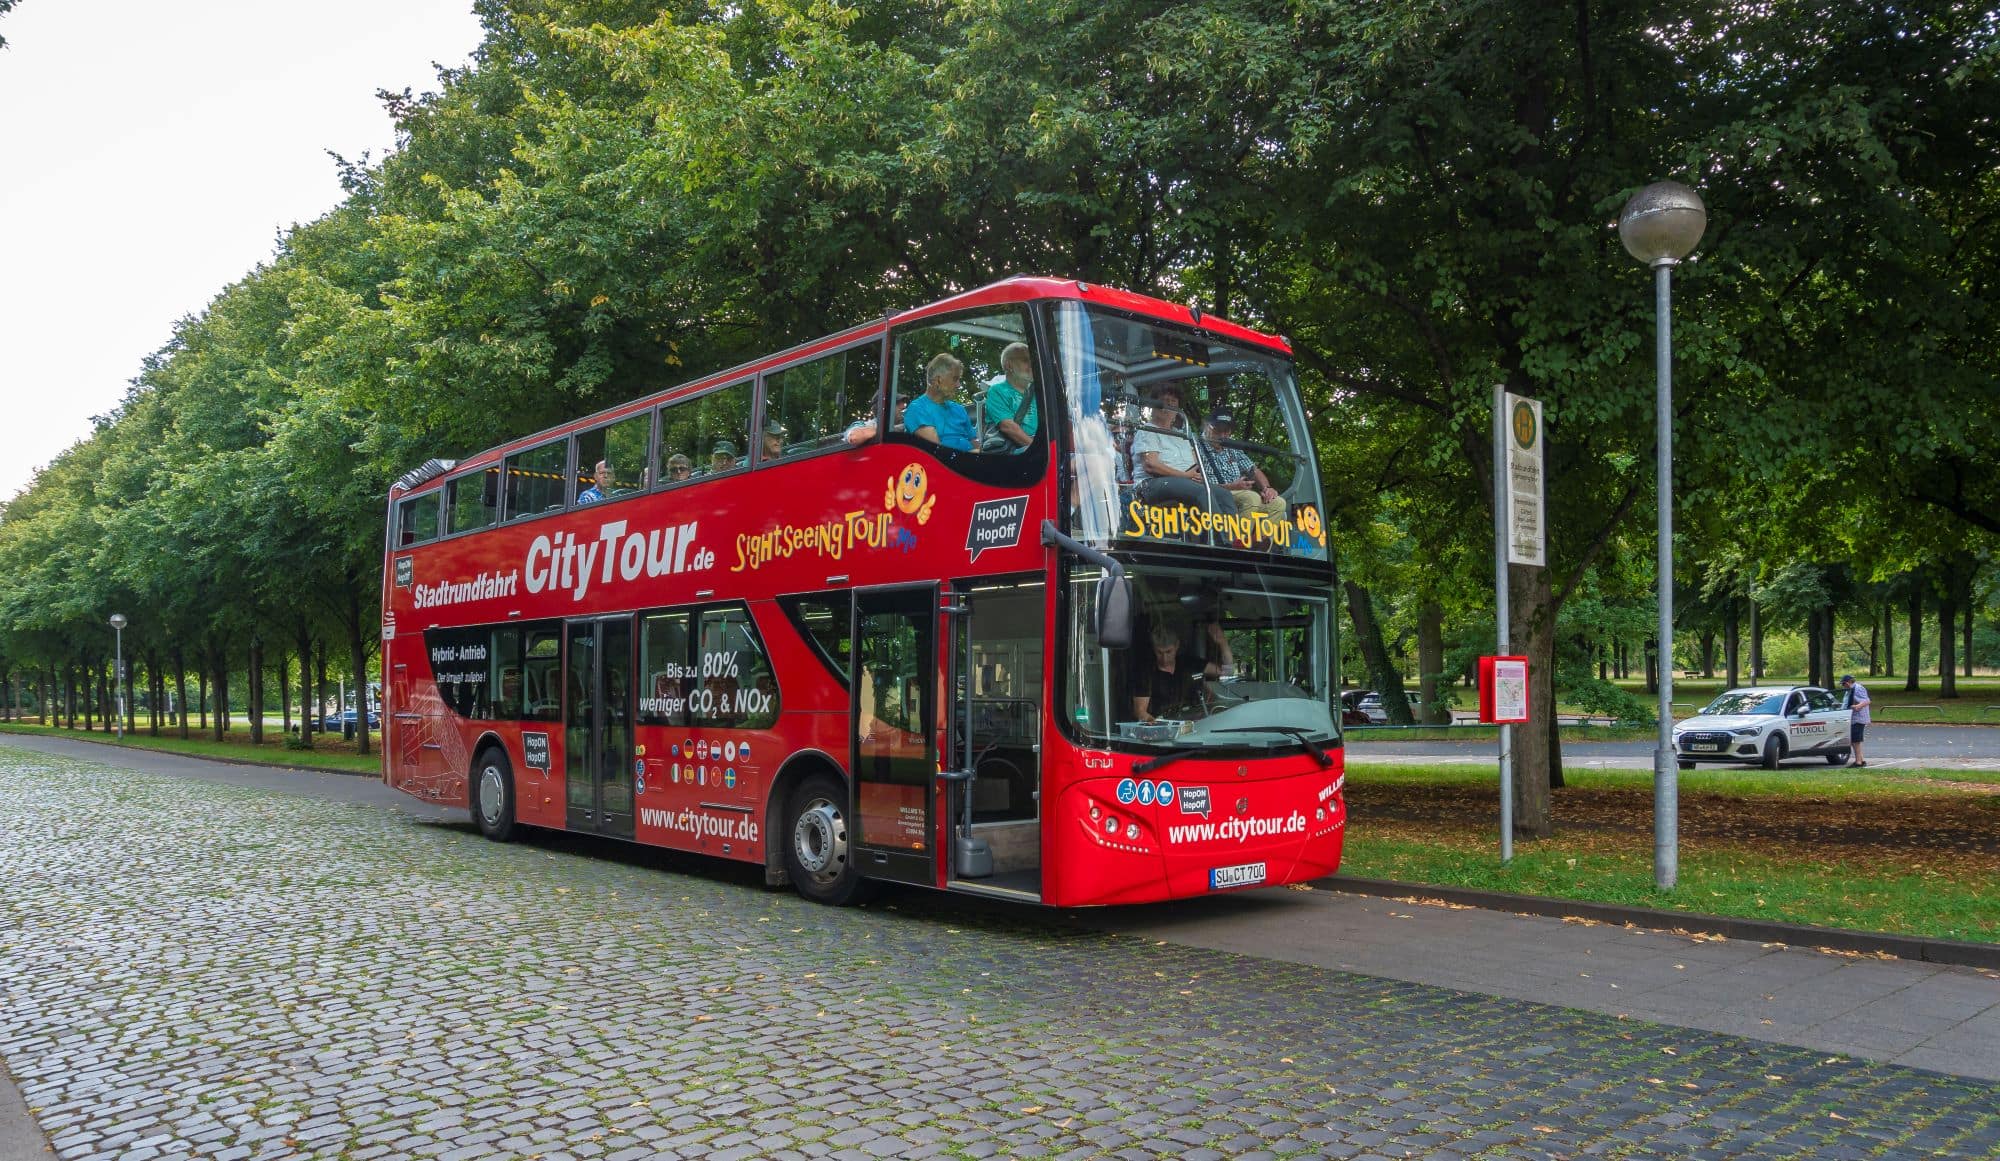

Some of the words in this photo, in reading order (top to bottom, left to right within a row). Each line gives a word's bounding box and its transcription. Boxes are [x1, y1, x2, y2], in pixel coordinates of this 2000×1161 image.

[977, 503, 1017, 523] HopON
[976, 523, 1017, 543] HopOff
[414, 568, 518, 609] Stadtrundfahrt
[432, 647, 455, 664] Hybrid
[459, 644, 486, 660] Antrieb
[667, 663, 683, 678] Bis
[685, 666, 698, 678] zu
[702, 650, 739, 678] 80%
[639, 693, 686, 716] weniger
[720, 693, 730, 713] &
[734, 688, 772, 713] NOx
[527, 737, 546, 749] HopON
[1183, 790, 1207, 799] HopON
[1183, 800, 1206, 810] HopOff
[641, 807, 758, 841] www.citytour.de
[1168, 810, 1306, 844] www.citytour.de
[1216, 869, 1229, 884] SU
[1234, 867, 1245, 881] CT
[1247, 864, 1265, 879] 700
